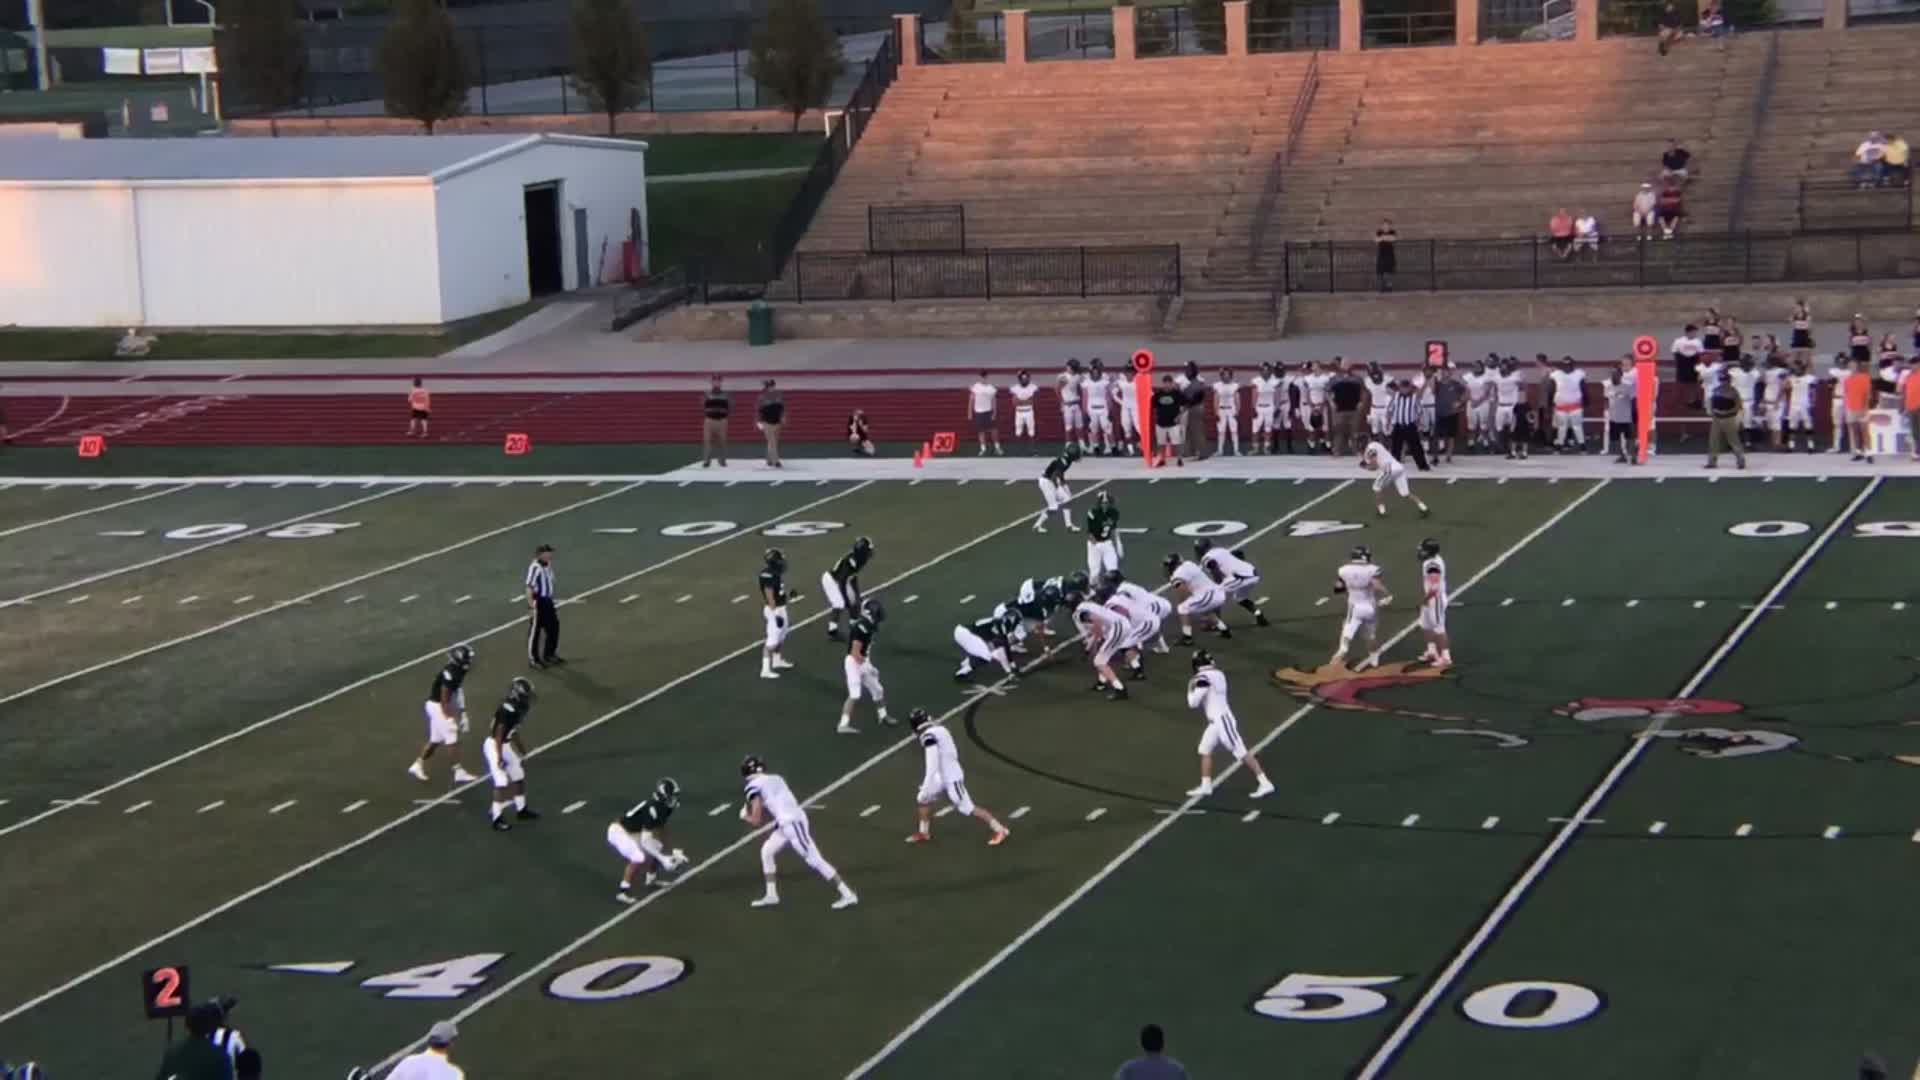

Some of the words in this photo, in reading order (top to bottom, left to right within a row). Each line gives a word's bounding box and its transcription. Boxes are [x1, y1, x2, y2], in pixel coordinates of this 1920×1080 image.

[1428, 343, 1444, 366] 2
[152, 967, 182, 1008] 2
[1253, 973, 1600, 1027] 50
